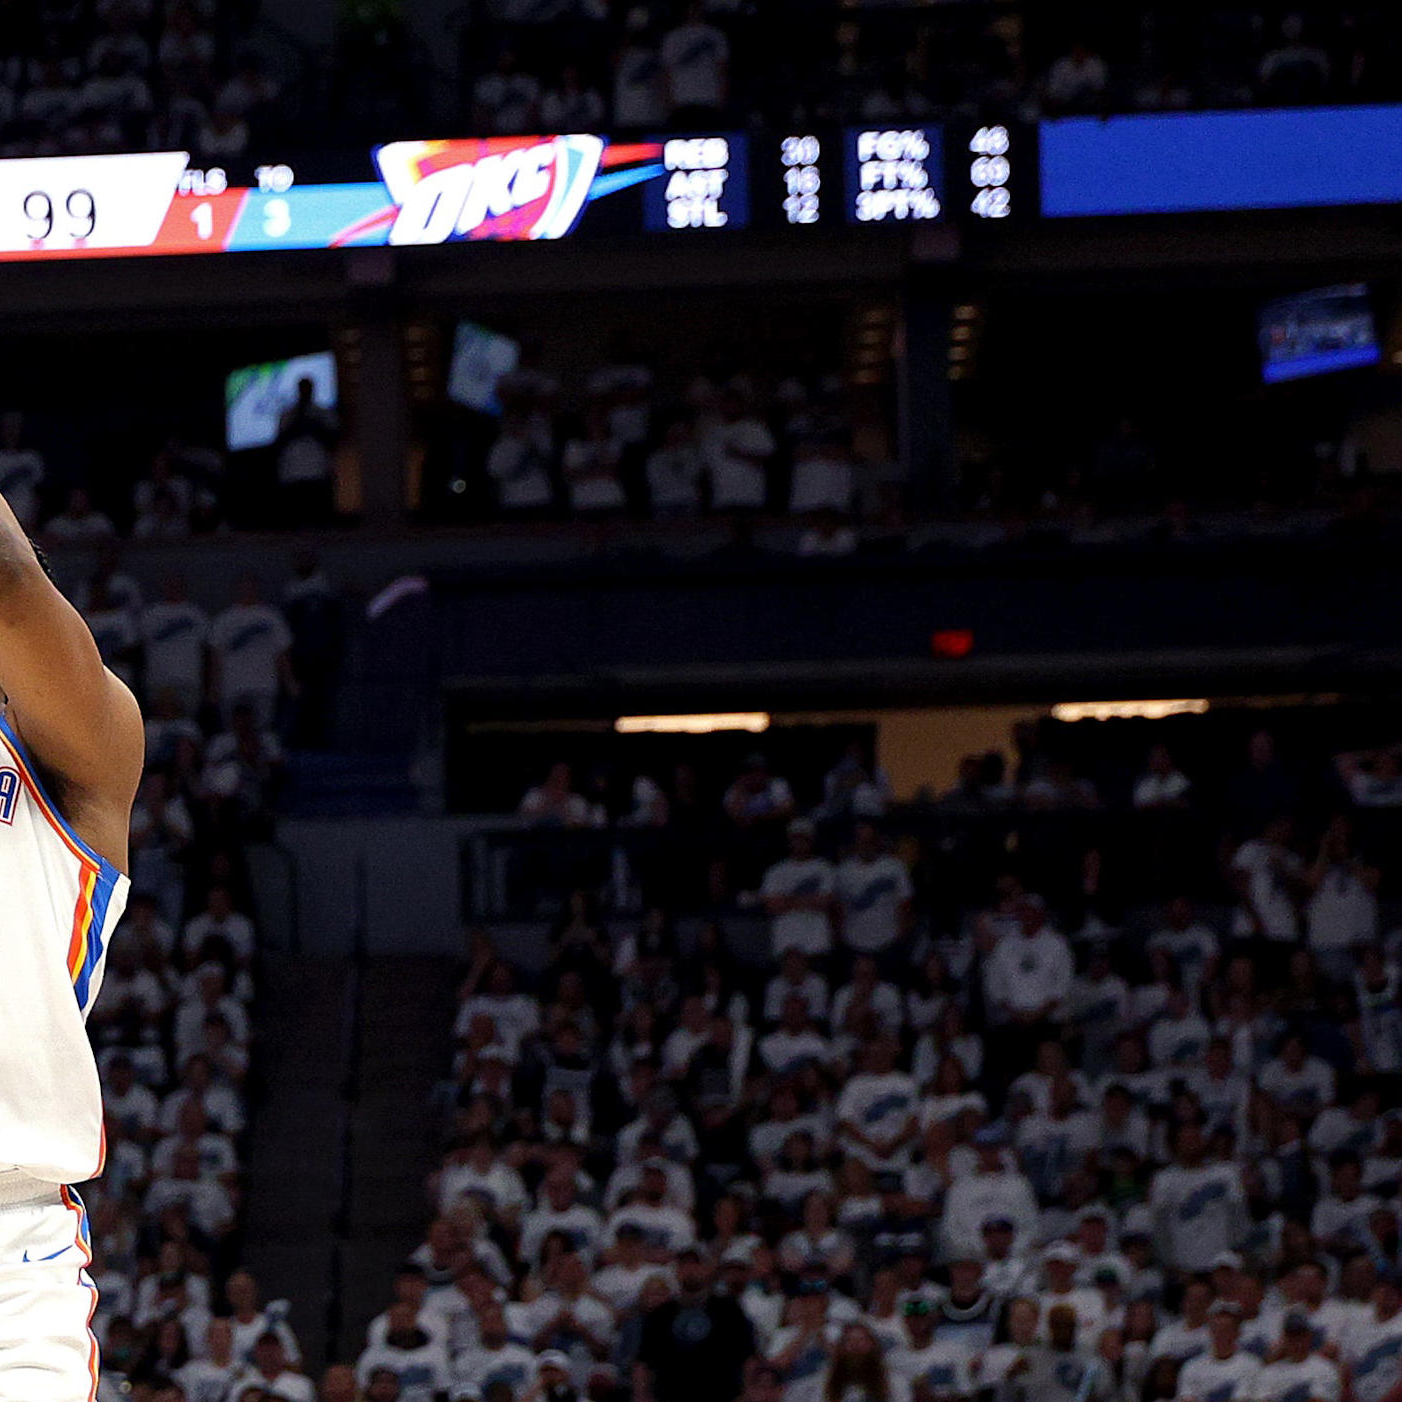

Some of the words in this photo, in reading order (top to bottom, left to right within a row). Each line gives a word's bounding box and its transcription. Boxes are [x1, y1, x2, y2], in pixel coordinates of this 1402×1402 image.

[23, 189, 97, 240] 99
[390, 142, 556, 245] OKC
[190, 202, 212, 240] 1
[263, 198, 291, 238] 3
